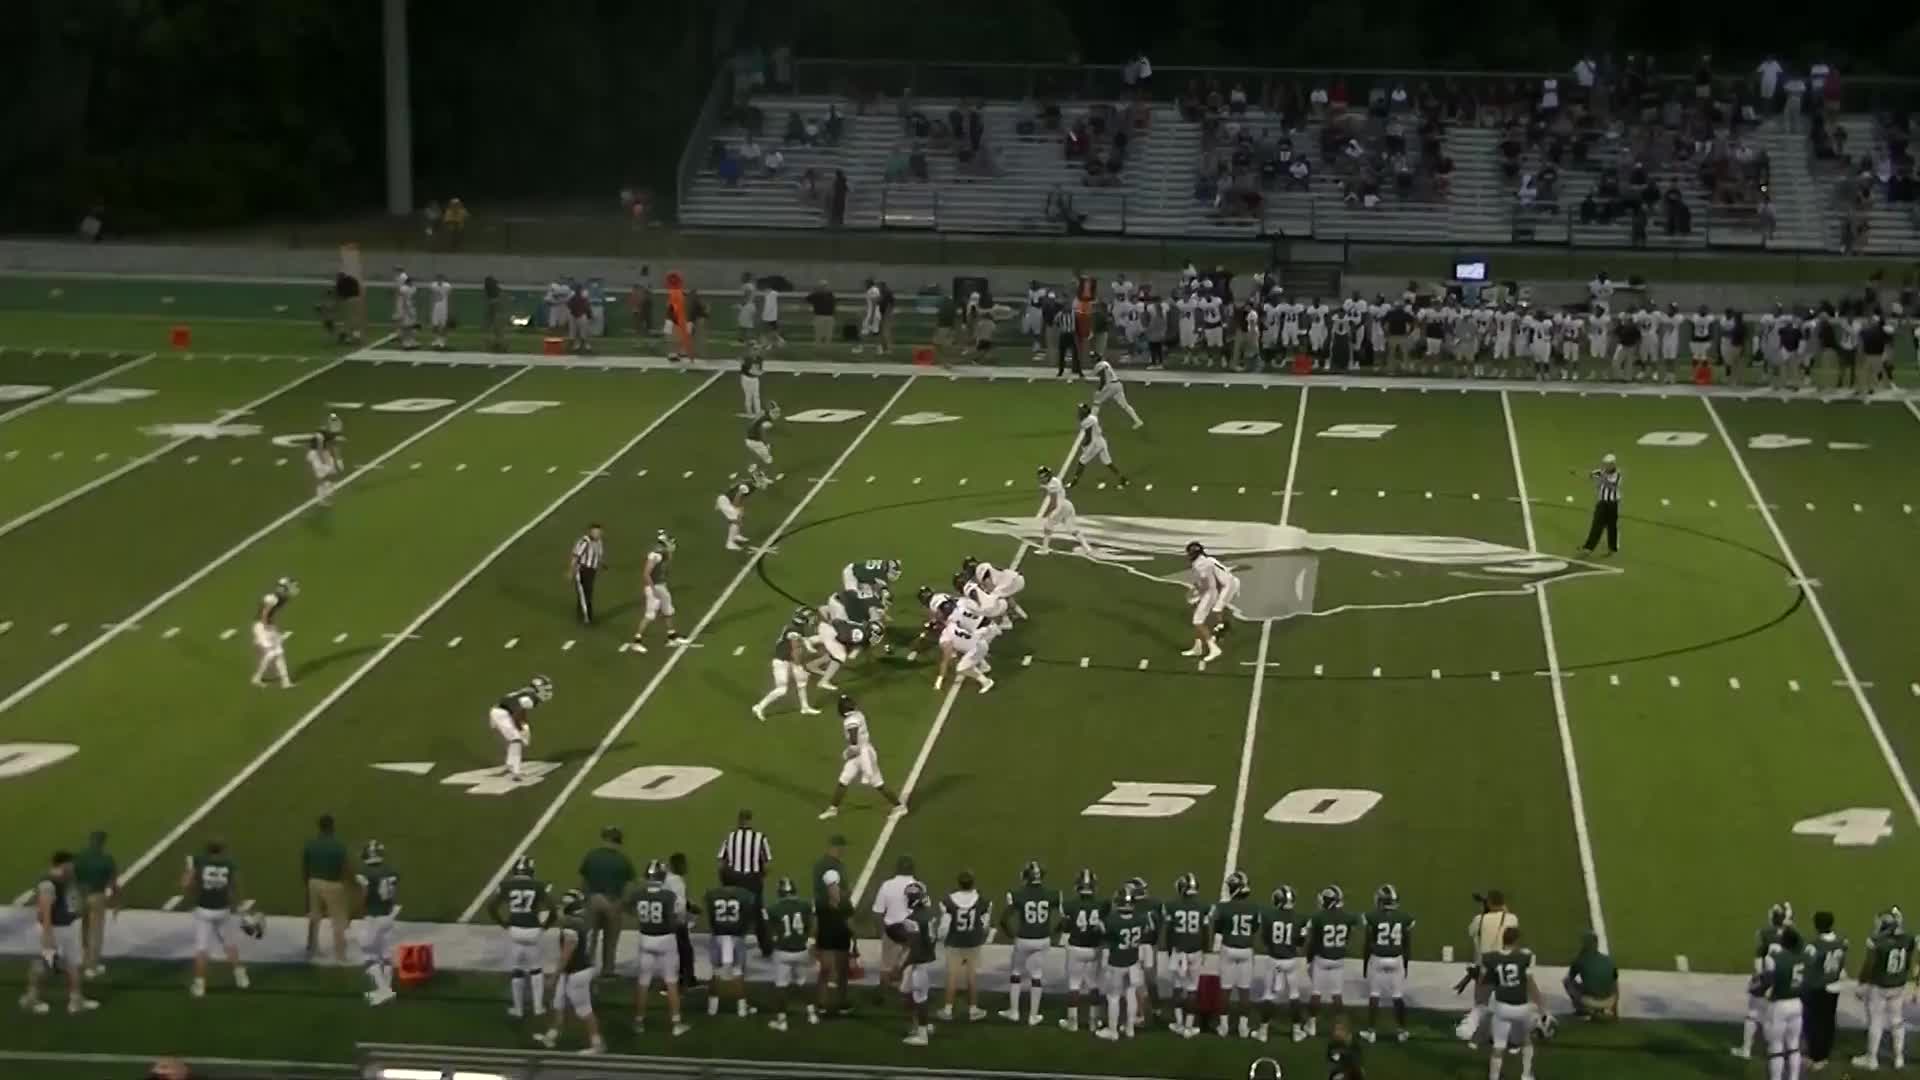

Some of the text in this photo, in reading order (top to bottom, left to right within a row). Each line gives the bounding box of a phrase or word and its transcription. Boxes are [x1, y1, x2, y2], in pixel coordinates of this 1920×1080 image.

[509, 889, 536, 914] 27
[714, 898, 740, 922] 23
[1024, 900, 1049, 924] 66
[782, 911, 805, 937] 14
[956, 908, 977, 932] 51
[1076, 909, 1101, 932] 44
[1175, 910, 1200, 933] 38
[1231, 914, 1253, 937] 15
[1119, 926, 1142, 951] 32
[1272, 920, 1292, 945] 81
[1322, 924, 1348, 948] 22
[1377, 921, 1402, 946] 24
[1497, 962, 1521, 988] 12
